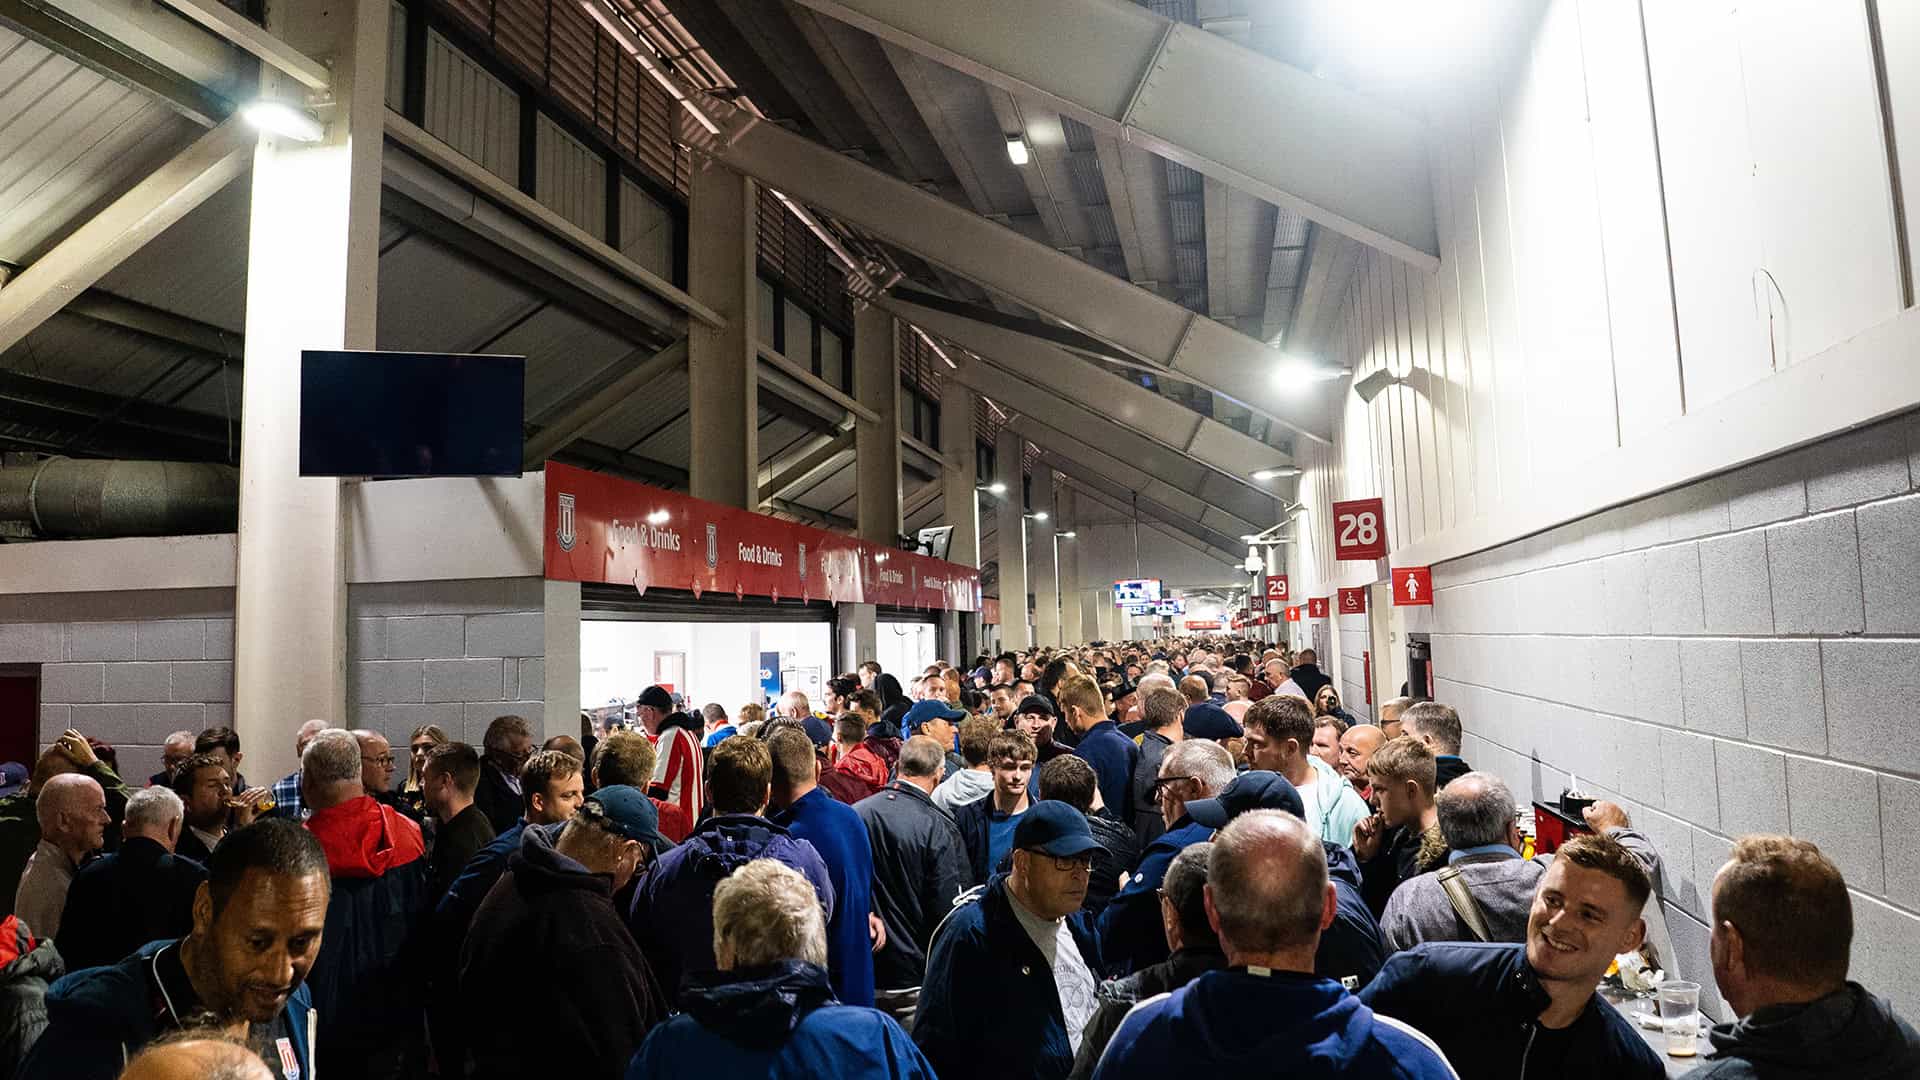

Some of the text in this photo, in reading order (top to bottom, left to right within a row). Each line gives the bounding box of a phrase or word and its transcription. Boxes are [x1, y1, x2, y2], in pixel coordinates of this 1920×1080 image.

[612, 519, 681, 551] Food & Drinks
[1339, 512, 1378, 546] 28
[738, 542, 783, 567] Food & Drinks
[1268, 580, 1286, 596] 29
[1251, 598, 1263, 609] 30
